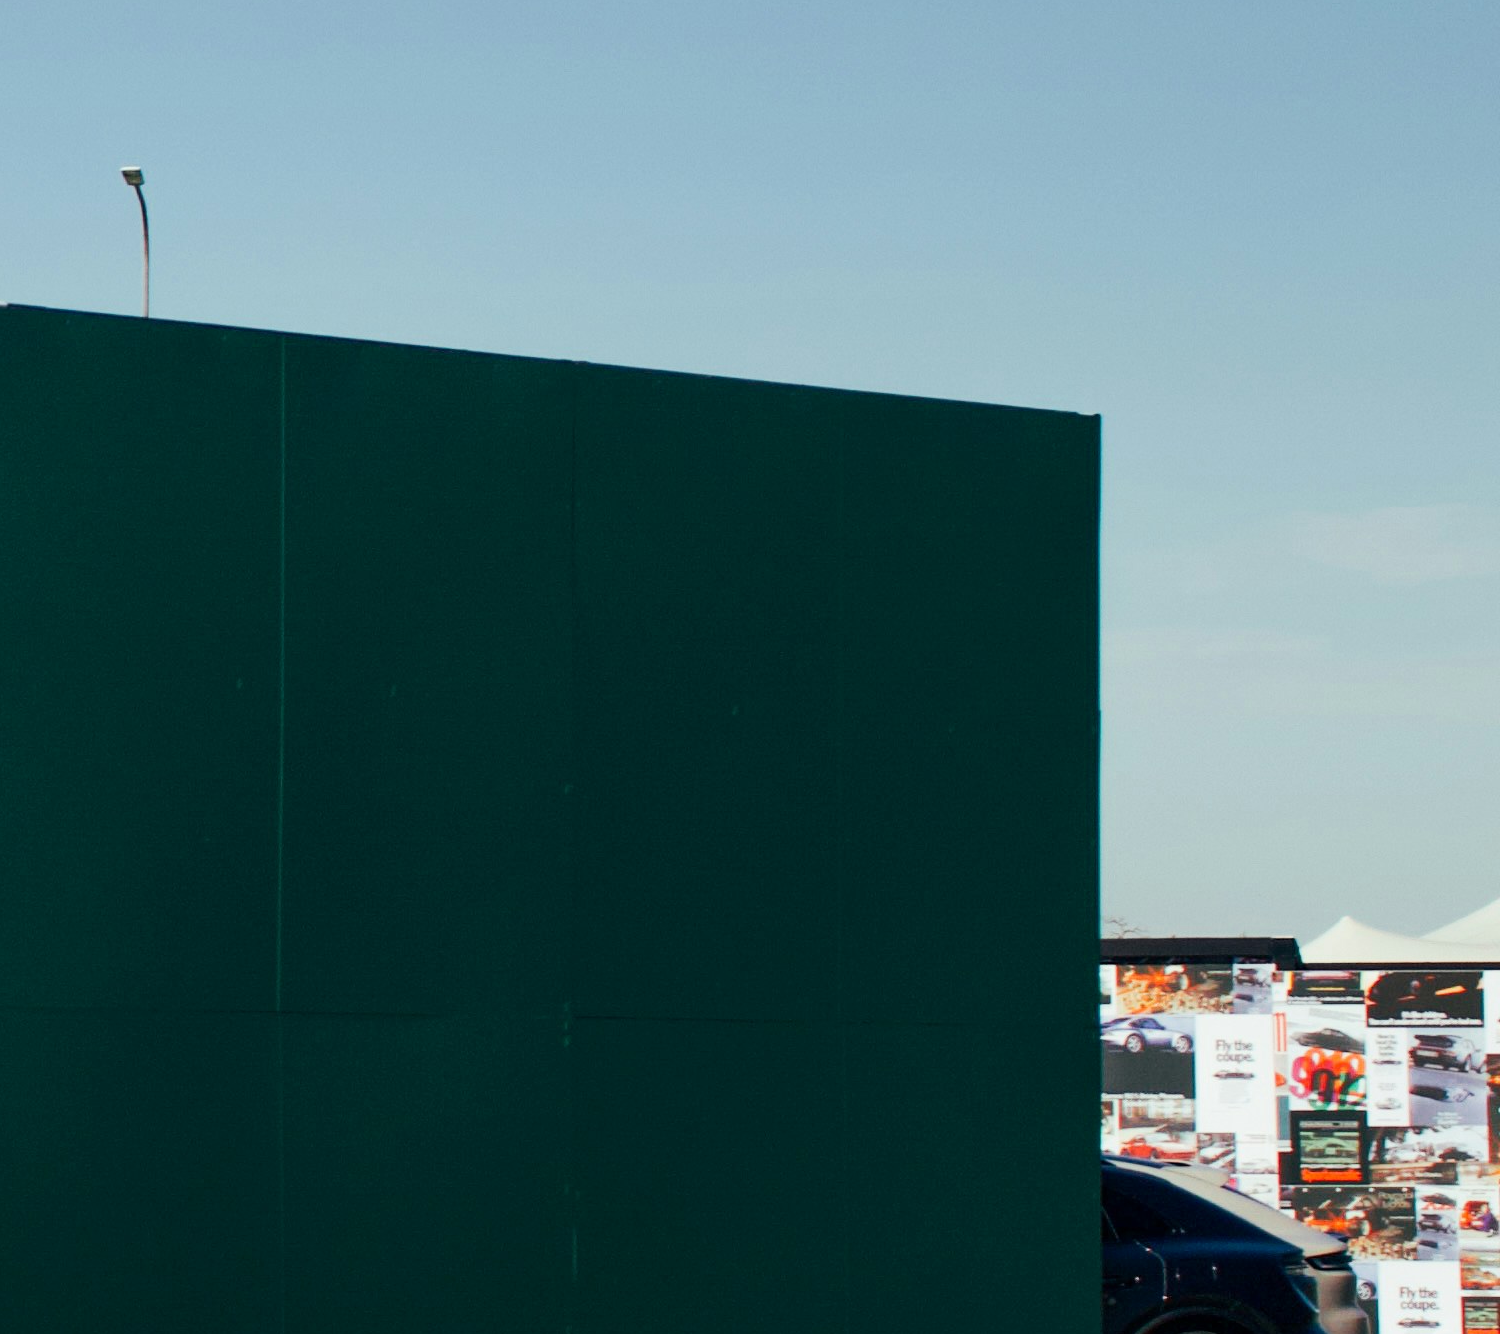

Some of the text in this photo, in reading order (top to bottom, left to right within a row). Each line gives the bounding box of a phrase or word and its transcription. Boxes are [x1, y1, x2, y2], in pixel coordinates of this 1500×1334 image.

[1216, 1039, 1253, 1052] Fly the
[1400, 1287, 1437, 1299] Fly the
